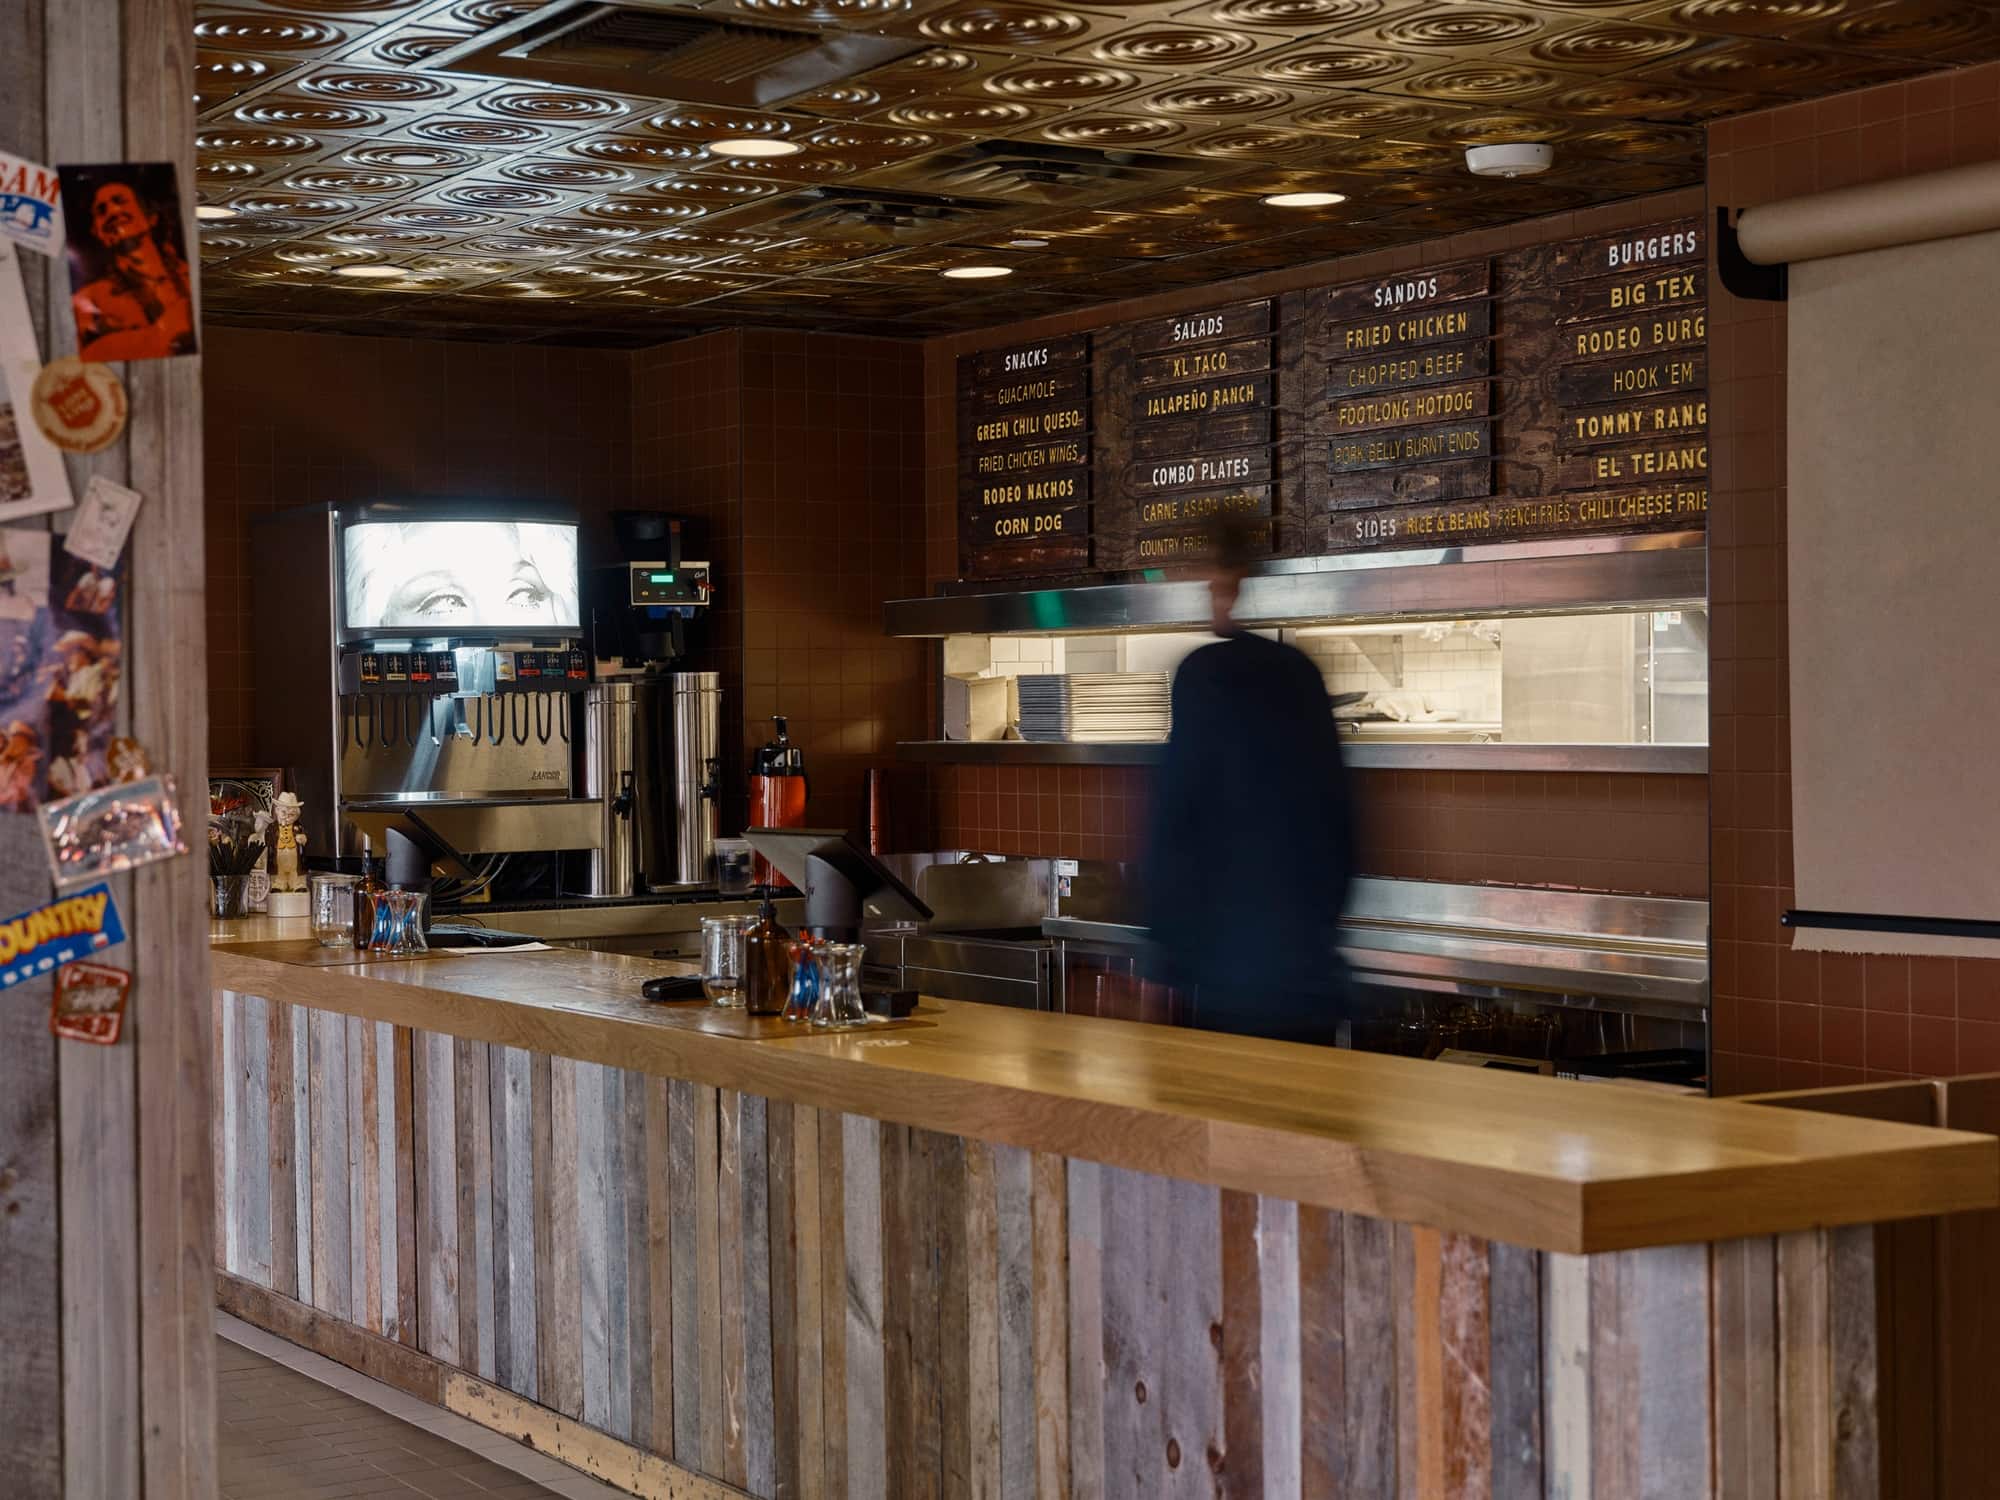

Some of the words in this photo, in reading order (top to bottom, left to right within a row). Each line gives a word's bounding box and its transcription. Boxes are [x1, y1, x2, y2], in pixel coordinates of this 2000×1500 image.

[1608, 231, 1696, 266] BURGERS
[1374, 277, 1437, 308] SANDOS
[1611, 282, 1647, 308] BIG
[1656, 274, 1696, 300] TEX
[1174, 315, 1223, 342] SALADS
[1346, 322, 1391, 349] FRIED
[1399, 311, 1467, 342] CHICKEN
[1578, 326, 1641, 355] RODEO
[1005, 348, 1048, 371] SNACKS
[1173, 357, 1189, 378] XL
[1194, 352, 1227, 374] TACO
[1349, 359, 1417, 388] CHOPPED
[1425, 352, 1464, 376] BEEF
[998, 380, 1056, 405] GUACAMOLE
[1614, 366, 1658, 393] HOOK
[1148, 389, 1208, 417] JALAPEÑO
[1213, 384, 1255, 407] RANCH
[1339, 399, 1409, 427] FOOTLONG
[1416, 391, 1473, 416] HOTDOG
[977, 421, 1009, 442] GREEN
[1013, 418, 1040, 436] CHILI
[1043, 409, 1080, 433] QUESO
[1575, 410, 1643, 438] TOMMY
[979, 454, 1005, 474] FRIED
[1007, 449, 1046, 471] CHICKEN
[1049, 443, 1079, 463] WINGS
[1368, 441, 1401, 463] BELLY
[1406, 434, 1445, 458] BURNT
[1448, 431, 1480, 453] ENDS
[1152, 463, 1196, 486] COMBO
[1201, 457, 1249, 481] PLATES
[1597, 457, 1621, 478] EL
[983, 485, 1022, 506] RODEO
[1027, 479, 1074, 501] NACHOS
[995, 517, 1029, 536] CORN
[1034, 514, 1062, 531] DOG
[1143, 501, 1178, 523] CARNE
[1355, 518, 1397, 540] SIDES
[1407, 515, 1433, 535] RICE
[1436, 513, 1445, 532] &
[1450, 510, 1490, 531] BEANS
[1497, 503, 1537, 529] FRENCH
[1540, 503, 1570, 524] FRIES
[1579, 497, 1615, 522] CHILI
[1618, 493, 1672, 518] CHEESE
[1140, 536, 1180, 557] COUNTRY
